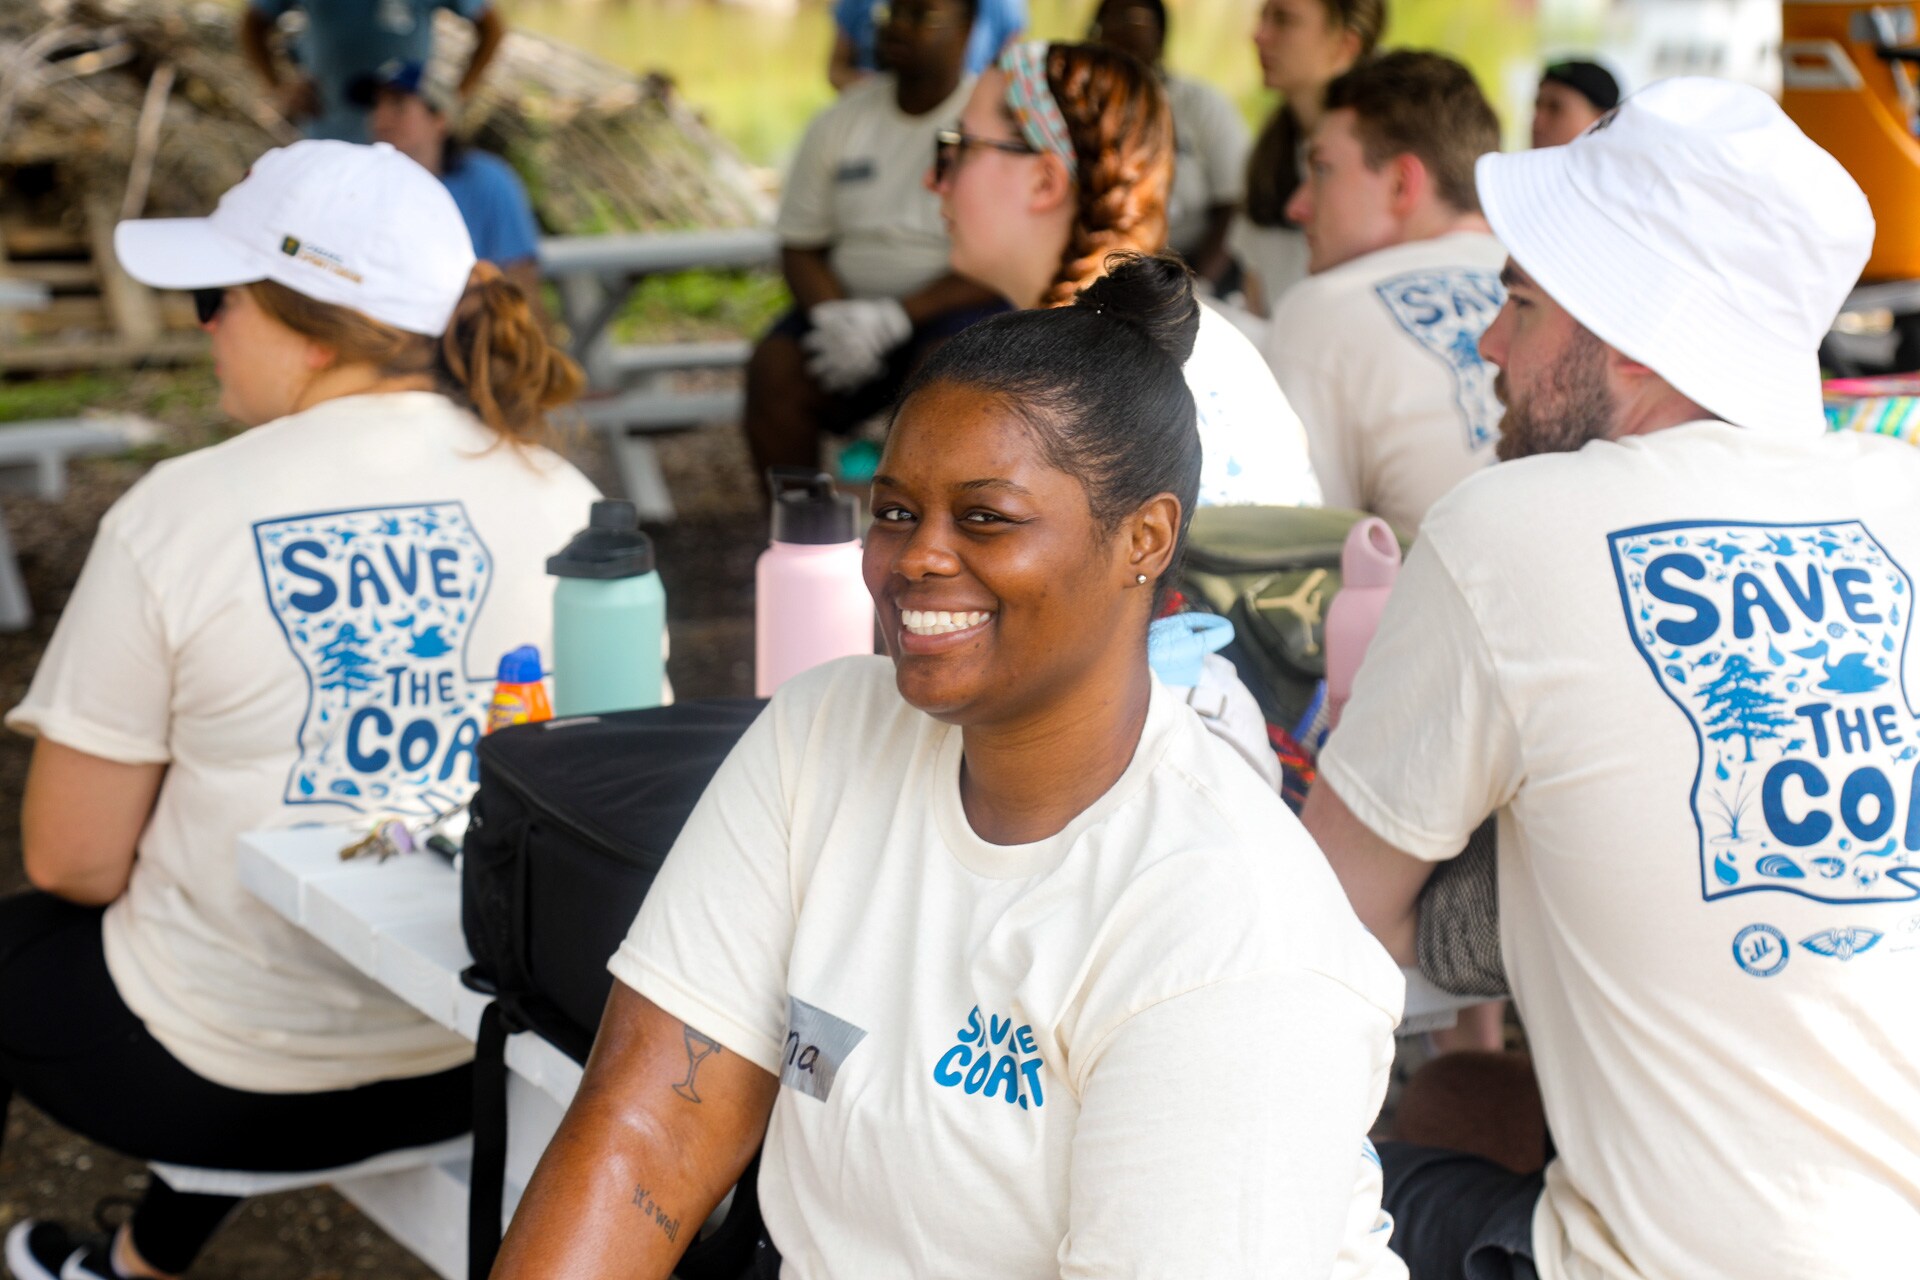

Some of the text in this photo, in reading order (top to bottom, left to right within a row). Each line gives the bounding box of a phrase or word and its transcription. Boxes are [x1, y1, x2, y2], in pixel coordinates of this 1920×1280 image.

[281, 540, 462, 613] SAVE
[1644, 553, 1883, 646] SAVE
[386, 666, 455, 706] THE
[1795, 703, 1903, 758] THE
[957, 1004, 1038, 1055] SVE
[933, 1044, 1044, 1110] COAT
